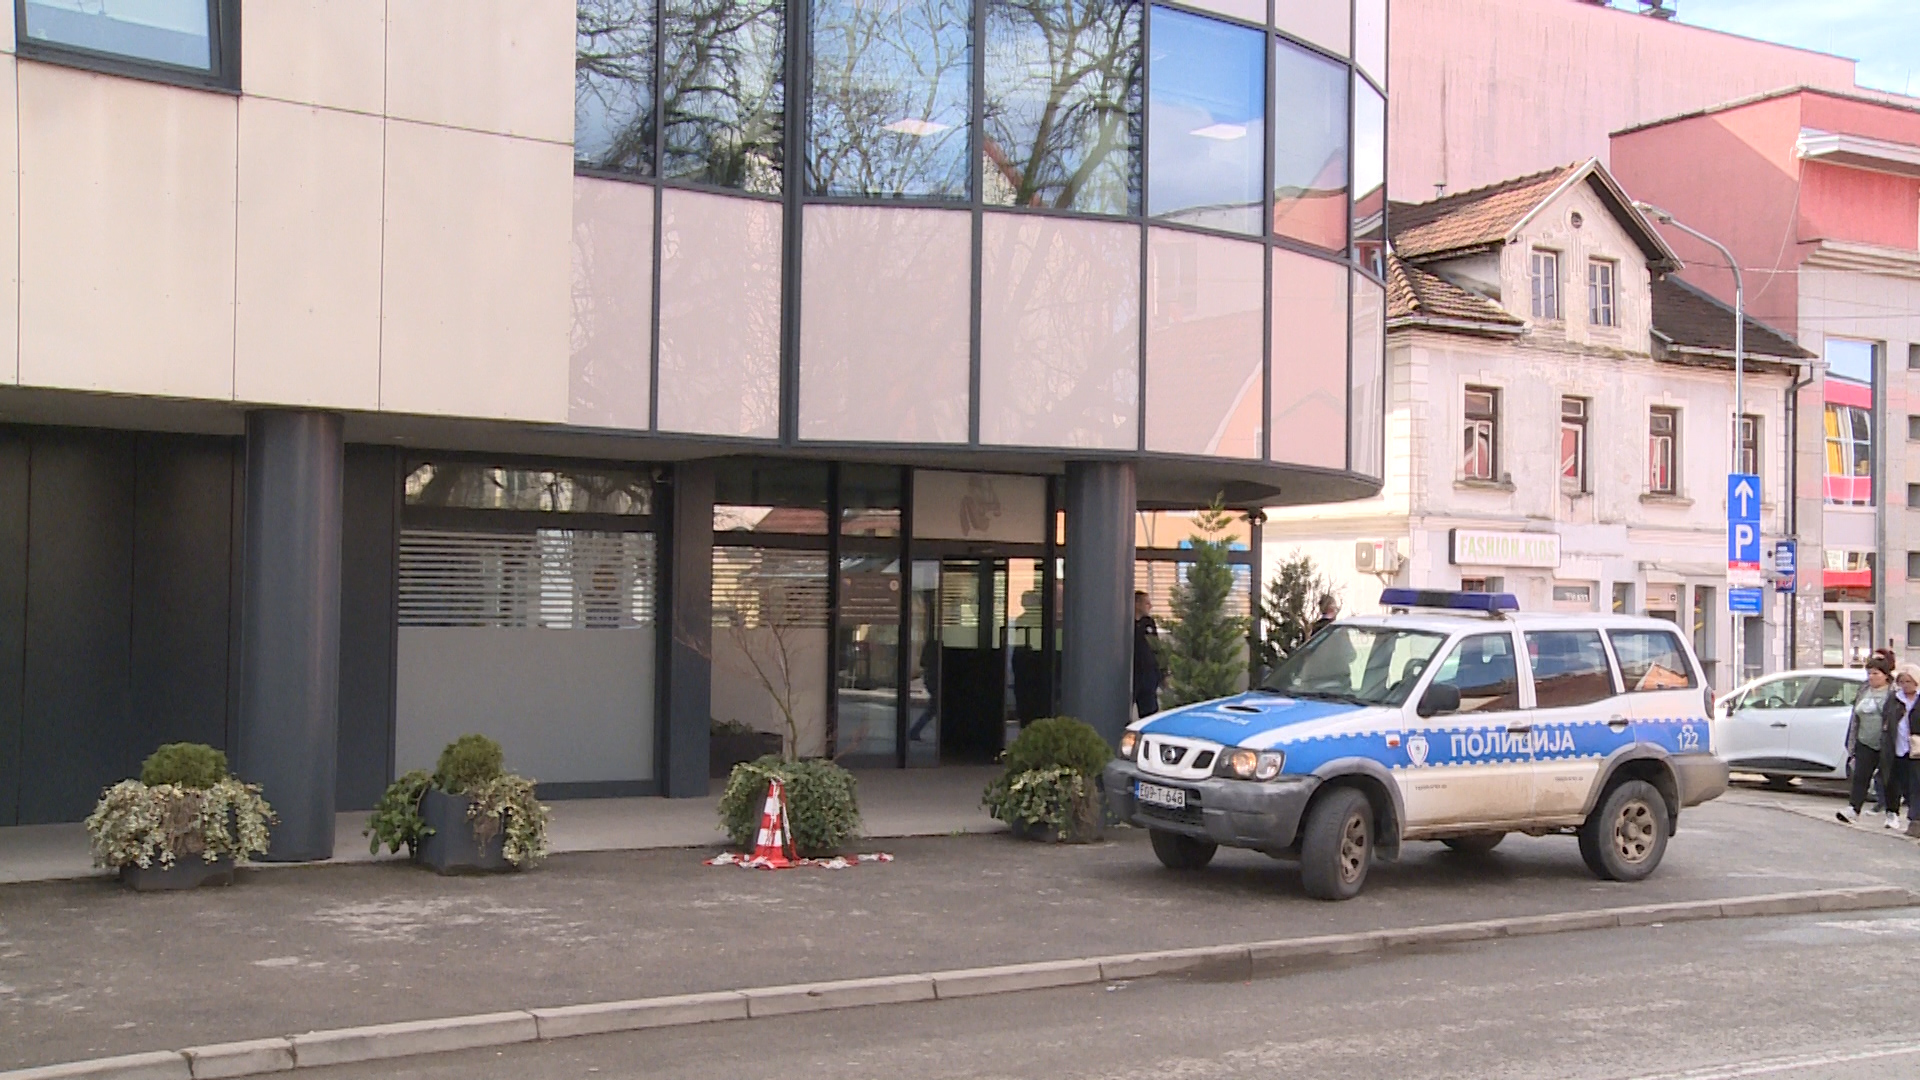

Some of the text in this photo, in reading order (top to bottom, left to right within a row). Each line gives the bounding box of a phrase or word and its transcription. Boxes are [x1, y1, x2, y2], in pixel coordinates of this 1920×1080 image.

[1461, 536, 1556, 561] FASHION KIDS
[1735, 523, 1754, 560] P
[1450, 729, 1577, 758] ПОЛИЦИЈА
[1676, 731, 1699, 751] 122
